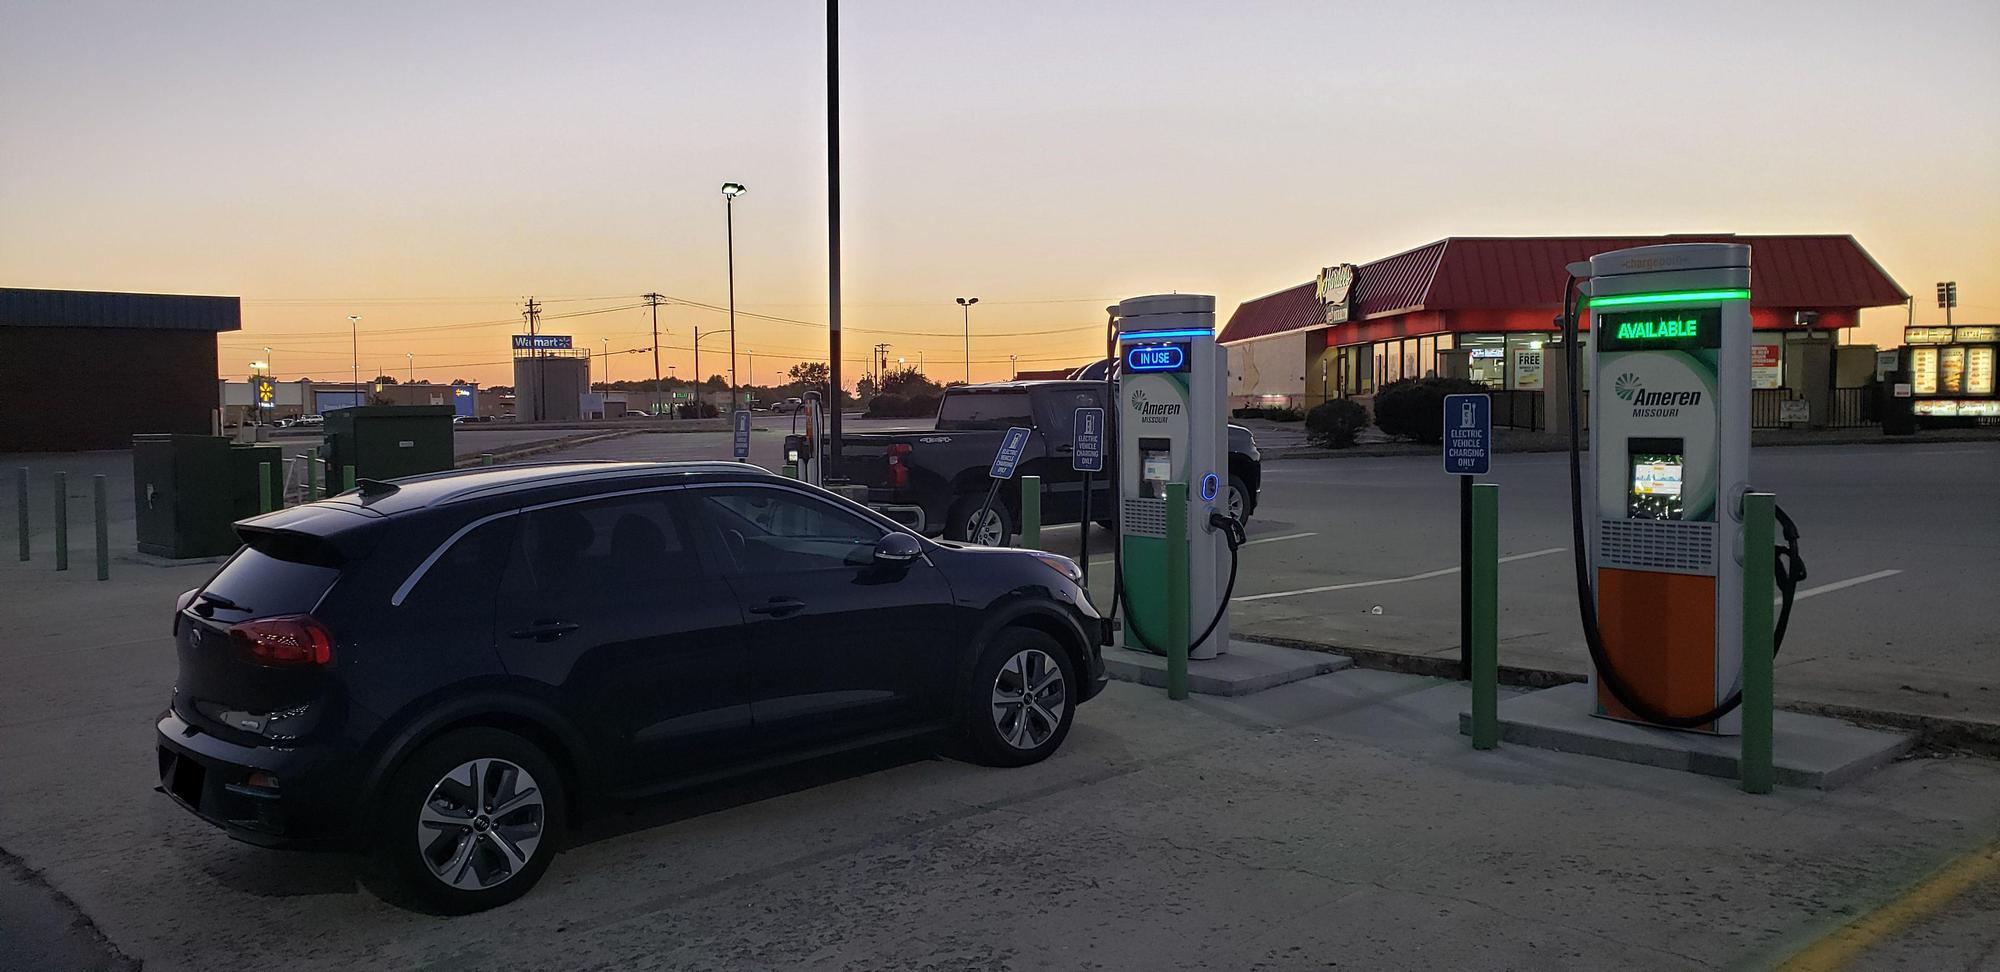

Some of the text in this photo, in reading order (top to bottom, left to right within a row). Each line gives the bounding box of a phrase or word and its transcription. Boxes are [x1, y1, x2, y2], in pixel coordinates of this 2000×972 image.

[1617, 319, 1697, 339] AVAILABLE
[515, 337, 558, 347] Wamart
[1141, 352, 1170, 365] IN USE
[1519, 355, 1540, 365] FREE
[1633, 388, 1701, 406] Ameren
[1142, 401, 1181, 415] Ameren
[1632, 408, 1679, 418] MISSOURI
[1142, 416, 1168, 424] MISSOURI
[1451, 429, 1483, 439] ELECTRIC
[1452, 439, 1481, 448] VEHICLE
[1449, 448, 1485, 458] CHARGING
[1458, 458, 1476, 467] ONLY
